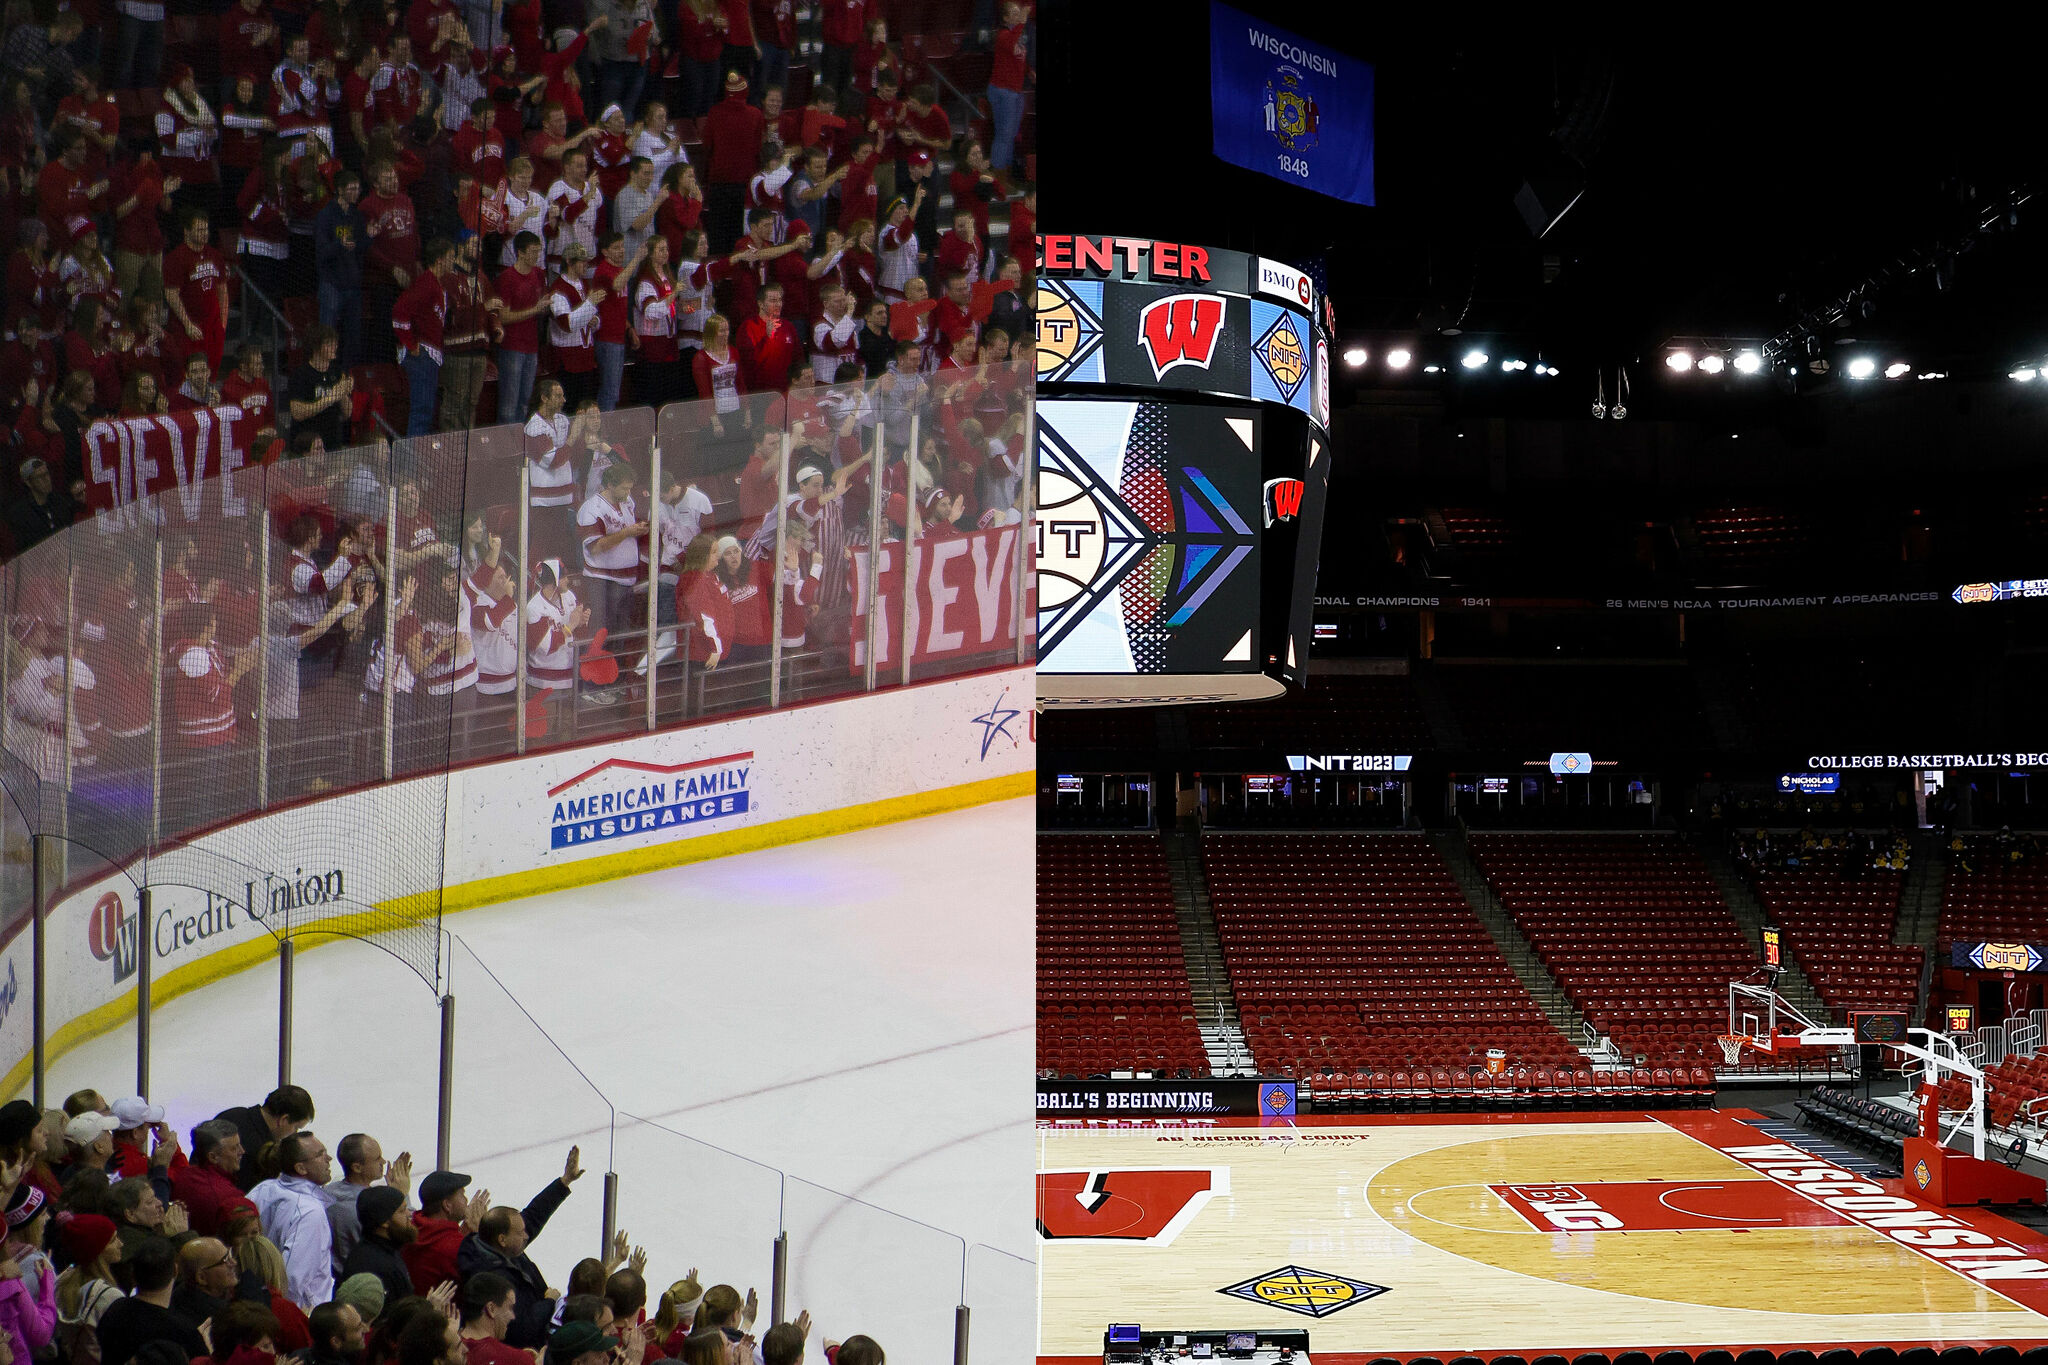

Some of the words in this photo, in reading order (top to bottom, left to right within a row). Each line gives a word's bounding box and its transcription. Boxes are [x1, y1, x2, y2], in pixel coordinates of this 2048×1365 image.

[1249, 28, 1337, 77] WISCONSIN
[1277, 153, 1309, 178] 1848
[1036, 235, 1211, 281] ENTER
[1263, 268, 1295, 291] BMO
[1271, 345, 1301, 367] NIT
[85, 405, 247, 535] SIEVE
[1356, 597, 1440, 606] CHAMPIONS
[1461, 597, 1491, 607] 1941
[1606, 599, 1623, 608] 26
[1628, 600, 1669, 608] MEN'S
[1674, 600, 1712, 609] NCAA
[1718, 597, 1827, 609] TOURNAMENT
[1832, 592, 1939, 604] APPEARANCES
[1963, 588, 1990, 599] NIT
[1306, 756, 1351, 771] NIT
[1353, 756, 1393, 771] 2023
[1808, 756, 1884, 768] COLLEGE
[1887, 754, 2012, 768] BASKETBALL'S
[1791, 777, 1834, 785] NICHOLAS
[552, 782, 666, 824] AMERICAN
[675, 767, 750, 801] FAMILY
[566, 797, 735, 843] INSURANCE
[154, 890, 237, 959] Credit
[246, 867, 346, 922] Union
[1766, 944, 1779, 965] 30
[1986, 951, 2026, 965] NIT
[1952, 1018, 1967, 1030] 30
[1036, 1093, 1099, 1109] BALL'S
[1106, 1092, 1213, 1109] BEGINNING
[1720, 1143, 2048, 1280] WISCONSIN
[1262, 1285, 1345, 1296] NIT
